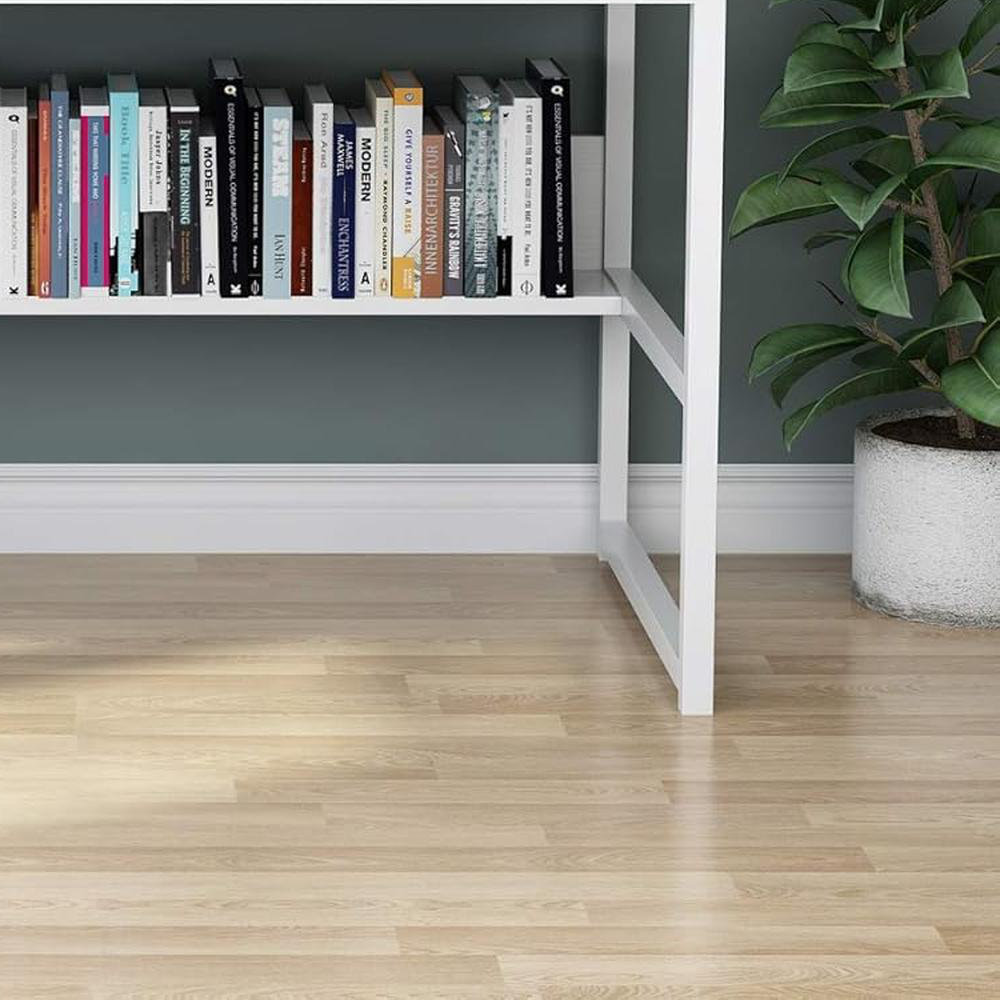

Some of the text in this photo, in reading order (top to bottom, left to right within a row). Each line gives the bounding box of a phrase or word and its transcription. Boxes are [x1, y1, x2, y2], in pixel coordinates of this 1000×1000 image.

[120, 105, 130, 185] Book Title
[179, 129, 192, 142] IN
[179, 143, 192, 165] THE
[320, 112, 328, 169] Ron Arad
[336, 133, 345, 177] MAXWELL
[346, 140, 354, 170] JAMES
[404, 129, 413, 150] GIVE
[204, 146, 214, 207] MODERN
[361, 138, 372, 202] MODERN
[404, 153, 413, 196] YOURSELF
[179, 165, 192, 225] BEGINNING
[271, 119, 290, 280] STEAM IAN HUNT
[424, 145, 439, 275] INNENARCHITEKTUR
[448, 196, 461, 238] GRAVITY'S
[404, 208, 413, 234] RAISE
[338, 217, 350, 291] ENCHANTRESS
[448, 239, 461, 280] RAINBOW
